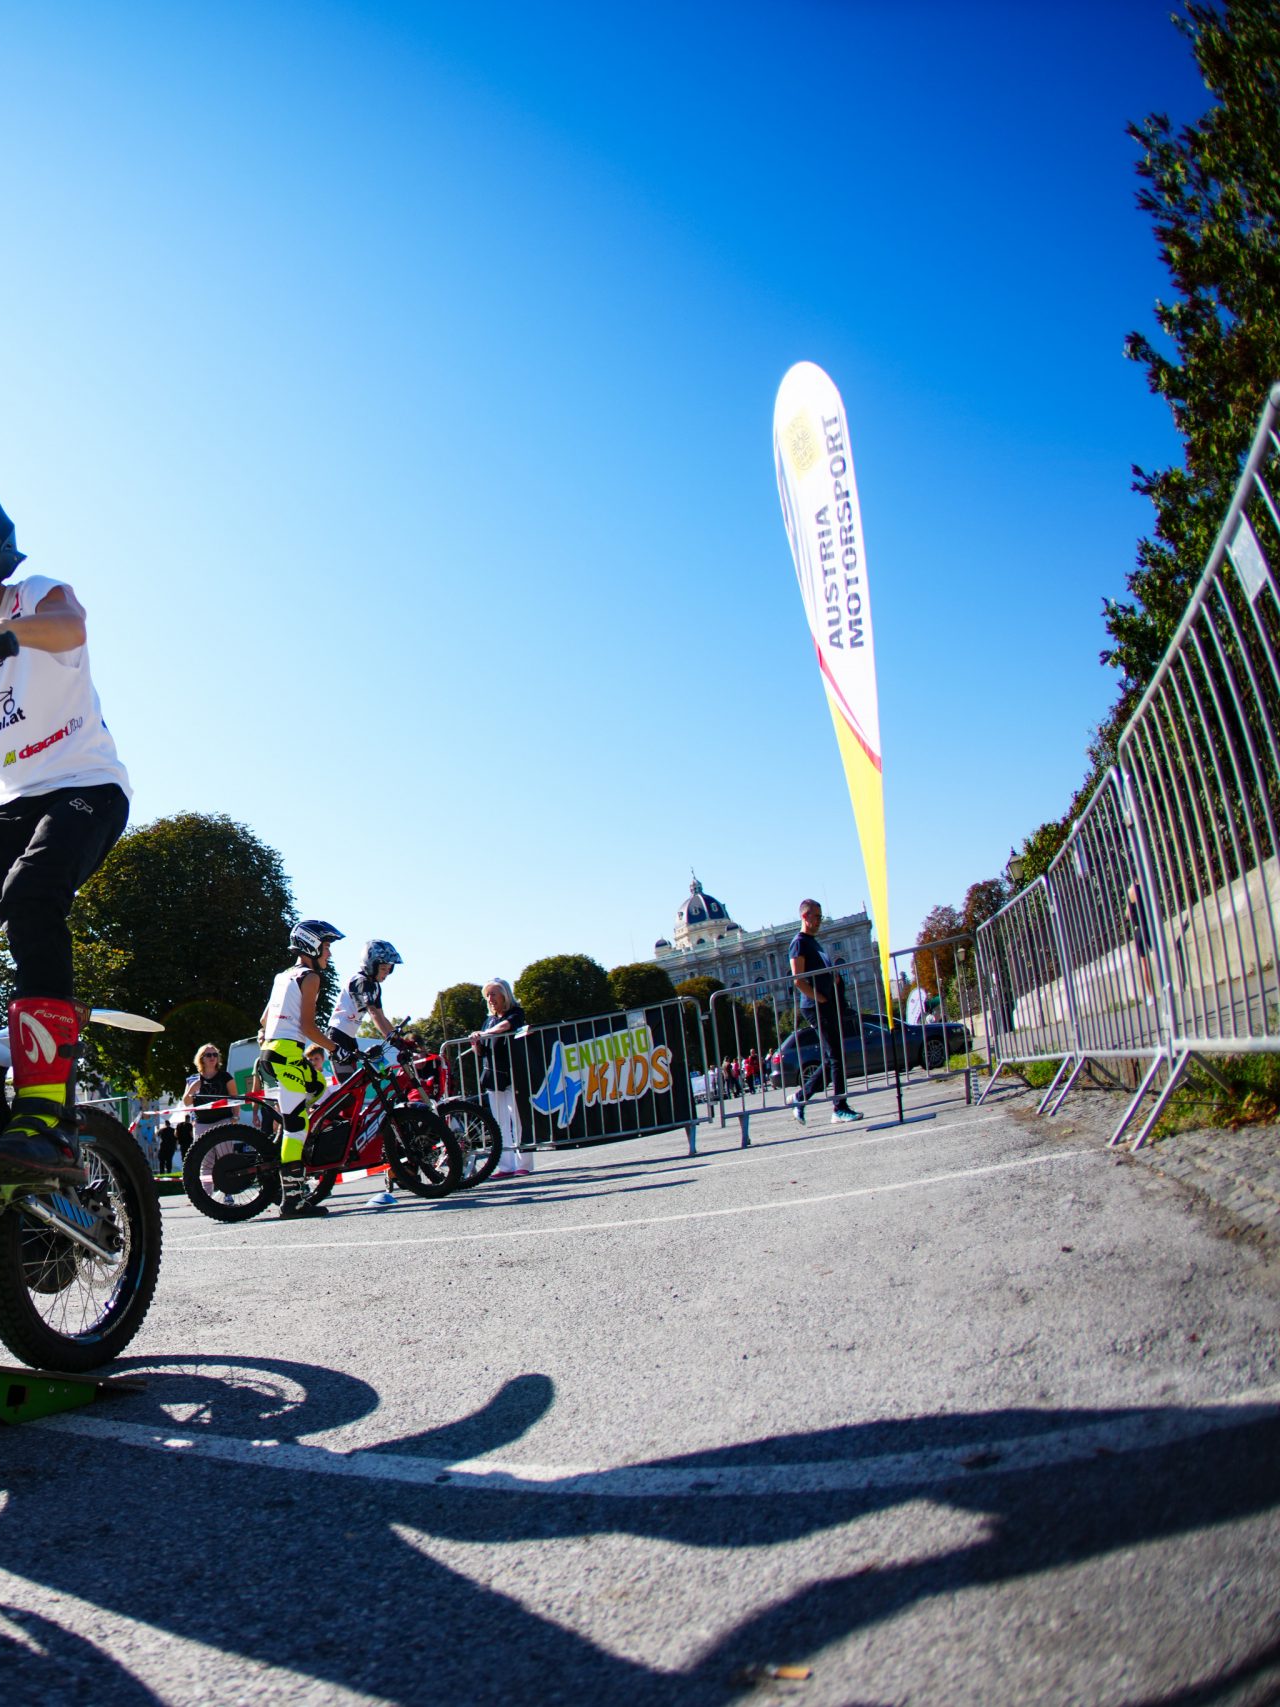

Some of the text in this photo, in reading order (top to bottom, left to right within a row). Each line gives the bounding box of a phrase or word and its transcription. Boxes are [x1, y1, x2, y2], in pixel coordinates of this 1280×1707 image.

[821, 415, 864, 649] MOTORSPORT
[815, 504, 844, 650] AUSTRIA
[33, 1009, 74, 1024] Forma
[564, 1028, 650, 1073] ENDURO
[586, 1047, 671, 1104] KIDS
